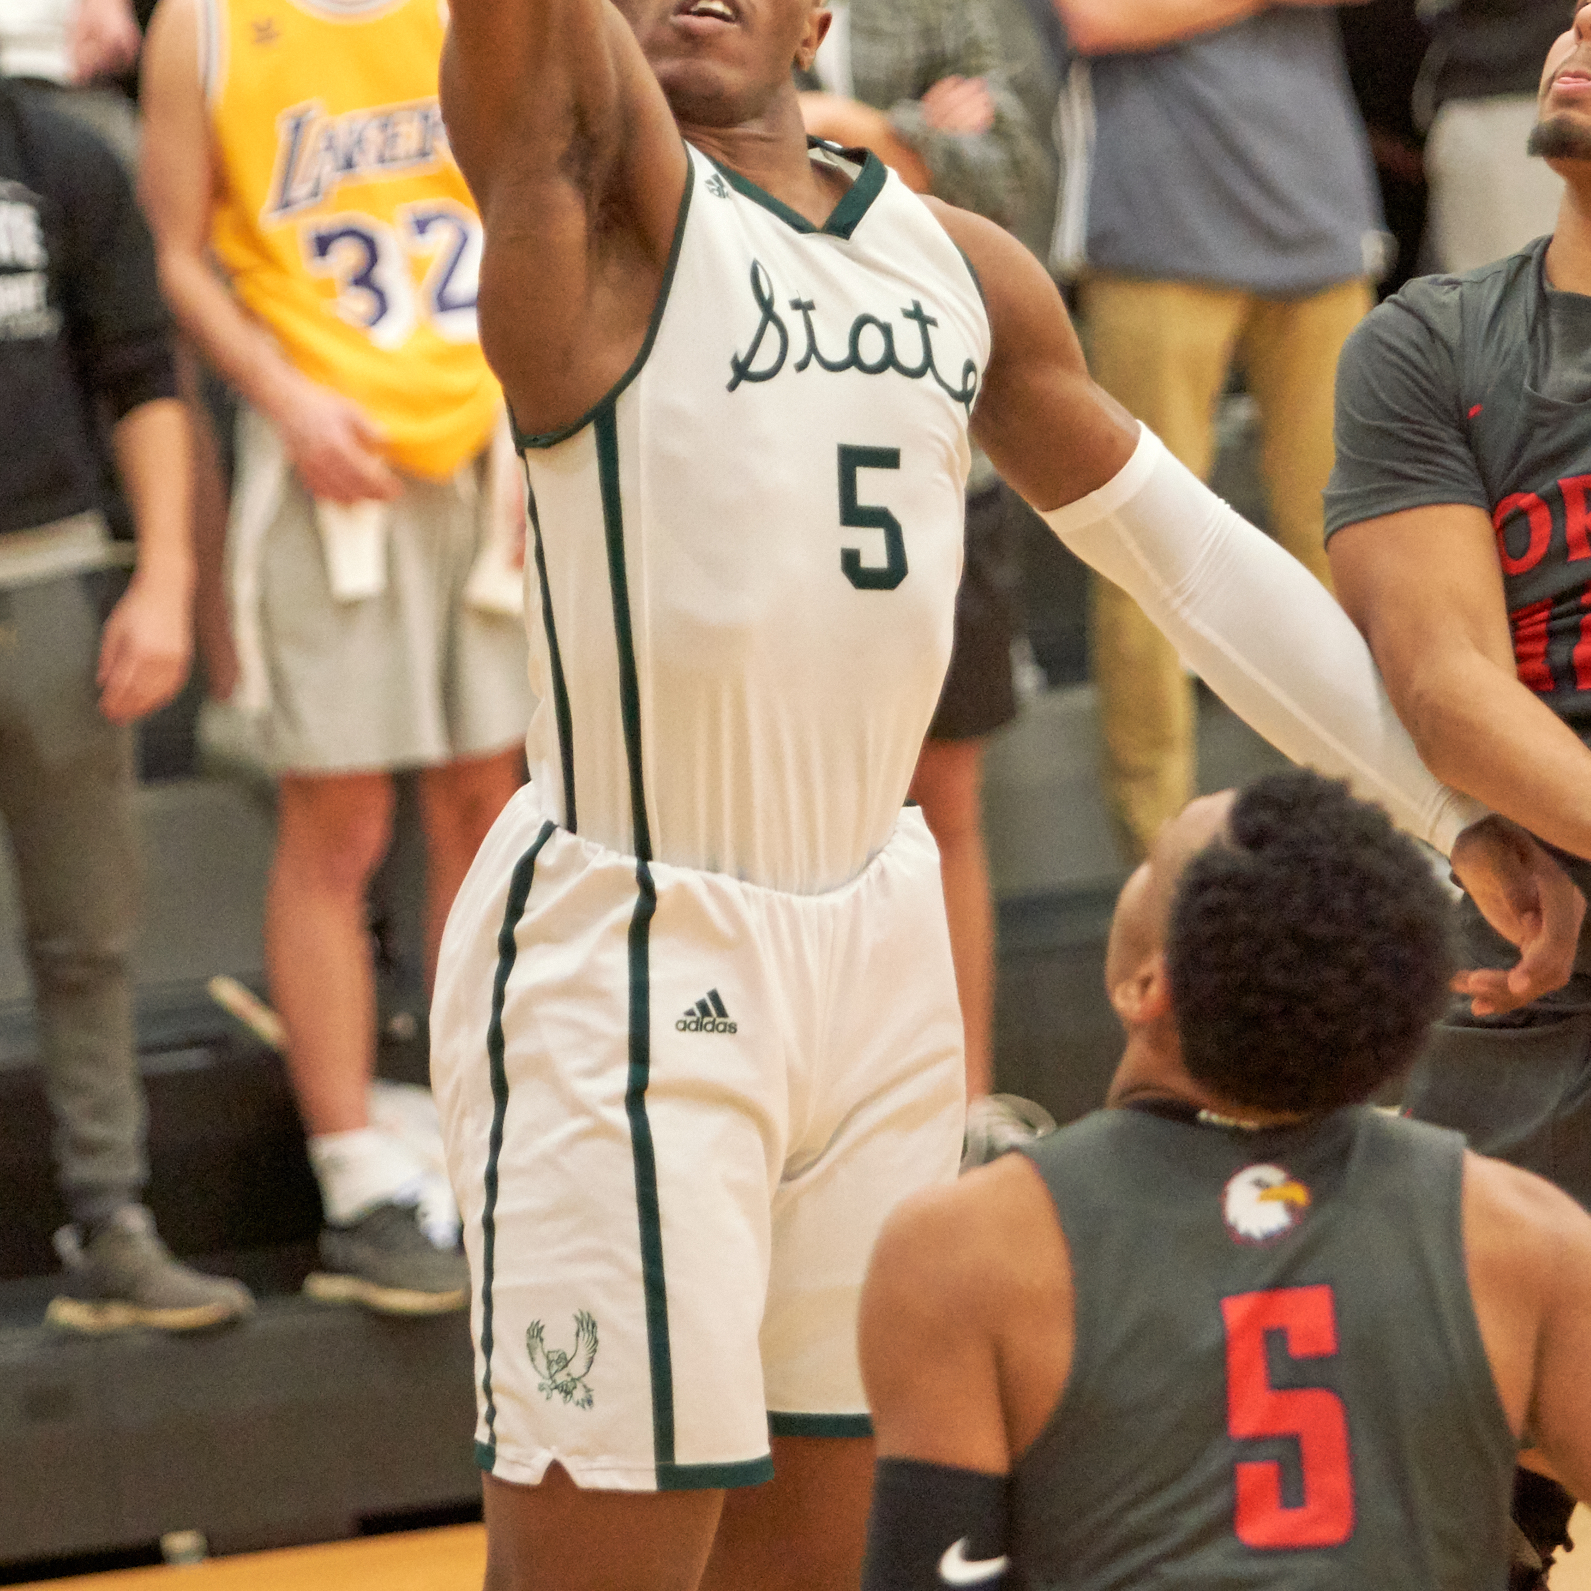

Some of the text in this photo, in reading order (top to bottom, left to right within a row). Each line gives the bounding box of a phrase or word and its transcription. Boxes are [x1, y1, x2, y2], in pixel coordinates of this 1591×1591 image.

[260, 97, 450, 229] LAKER
[300, 199, 483, 349] 32
[725, 257, 978, 417] State
[837, 443, 910, 592] 5
[675, 1016, 738, 1034] adidas
[1221, 1283, 1355, 1550] 5
